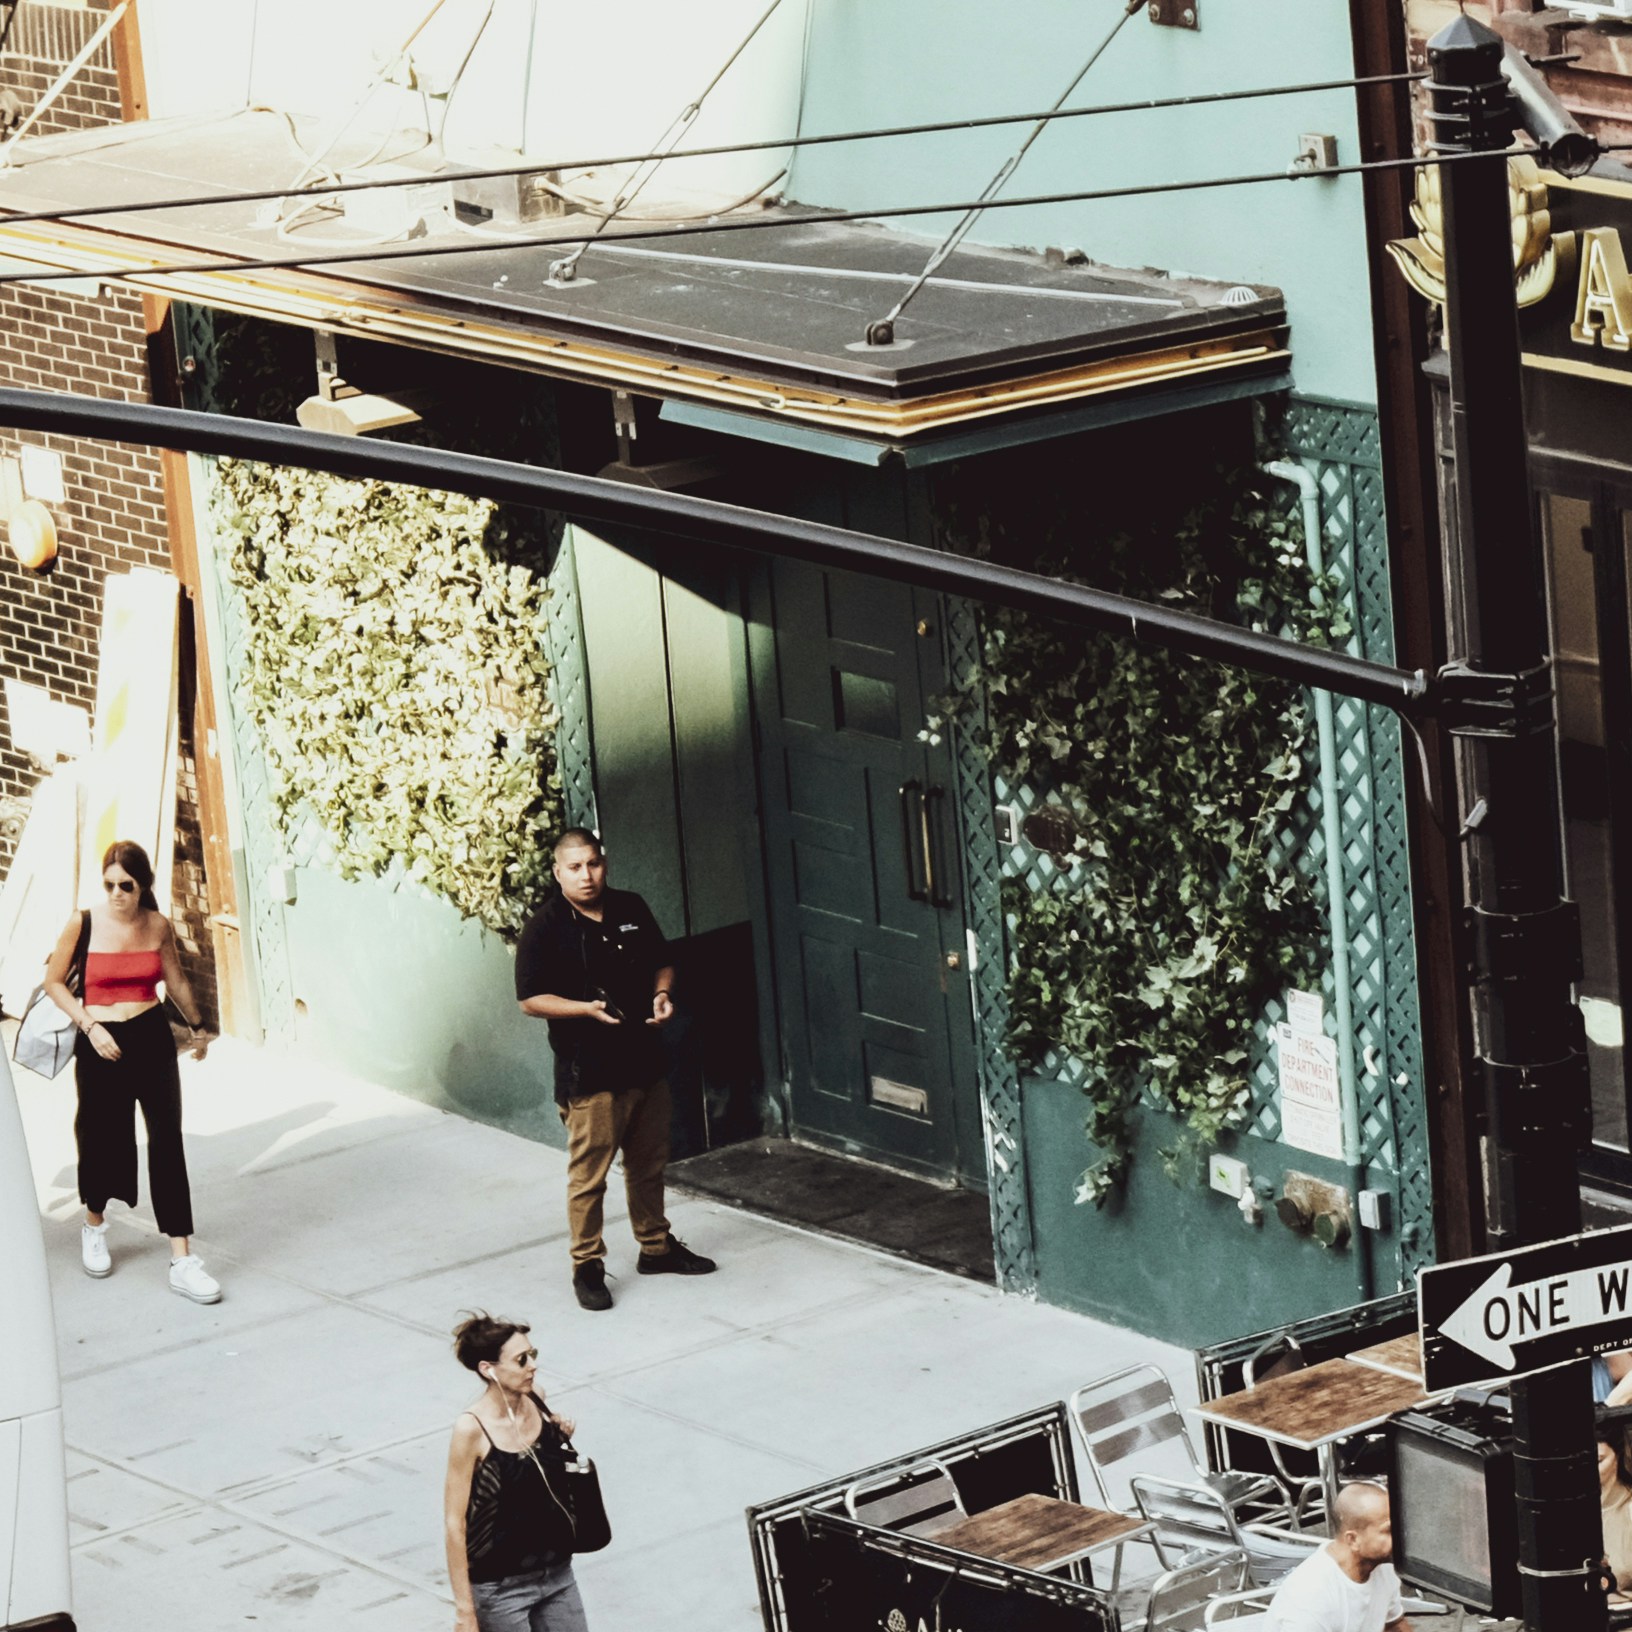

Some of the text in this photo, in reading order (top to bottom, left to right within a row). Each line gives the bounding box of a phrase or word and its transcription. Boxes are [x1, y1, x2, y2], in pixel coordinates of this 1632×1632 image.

[1298, 1037, 1314, 1056] FIRE
[1281, 1052, 1333, 1082] DEPARTMENT
[1285, 1074, 1333, 1103] CONNECTION
[1483, 1281, 1570, 1341] ONE
[1593, 1341, 1618, 1352] DEPT
